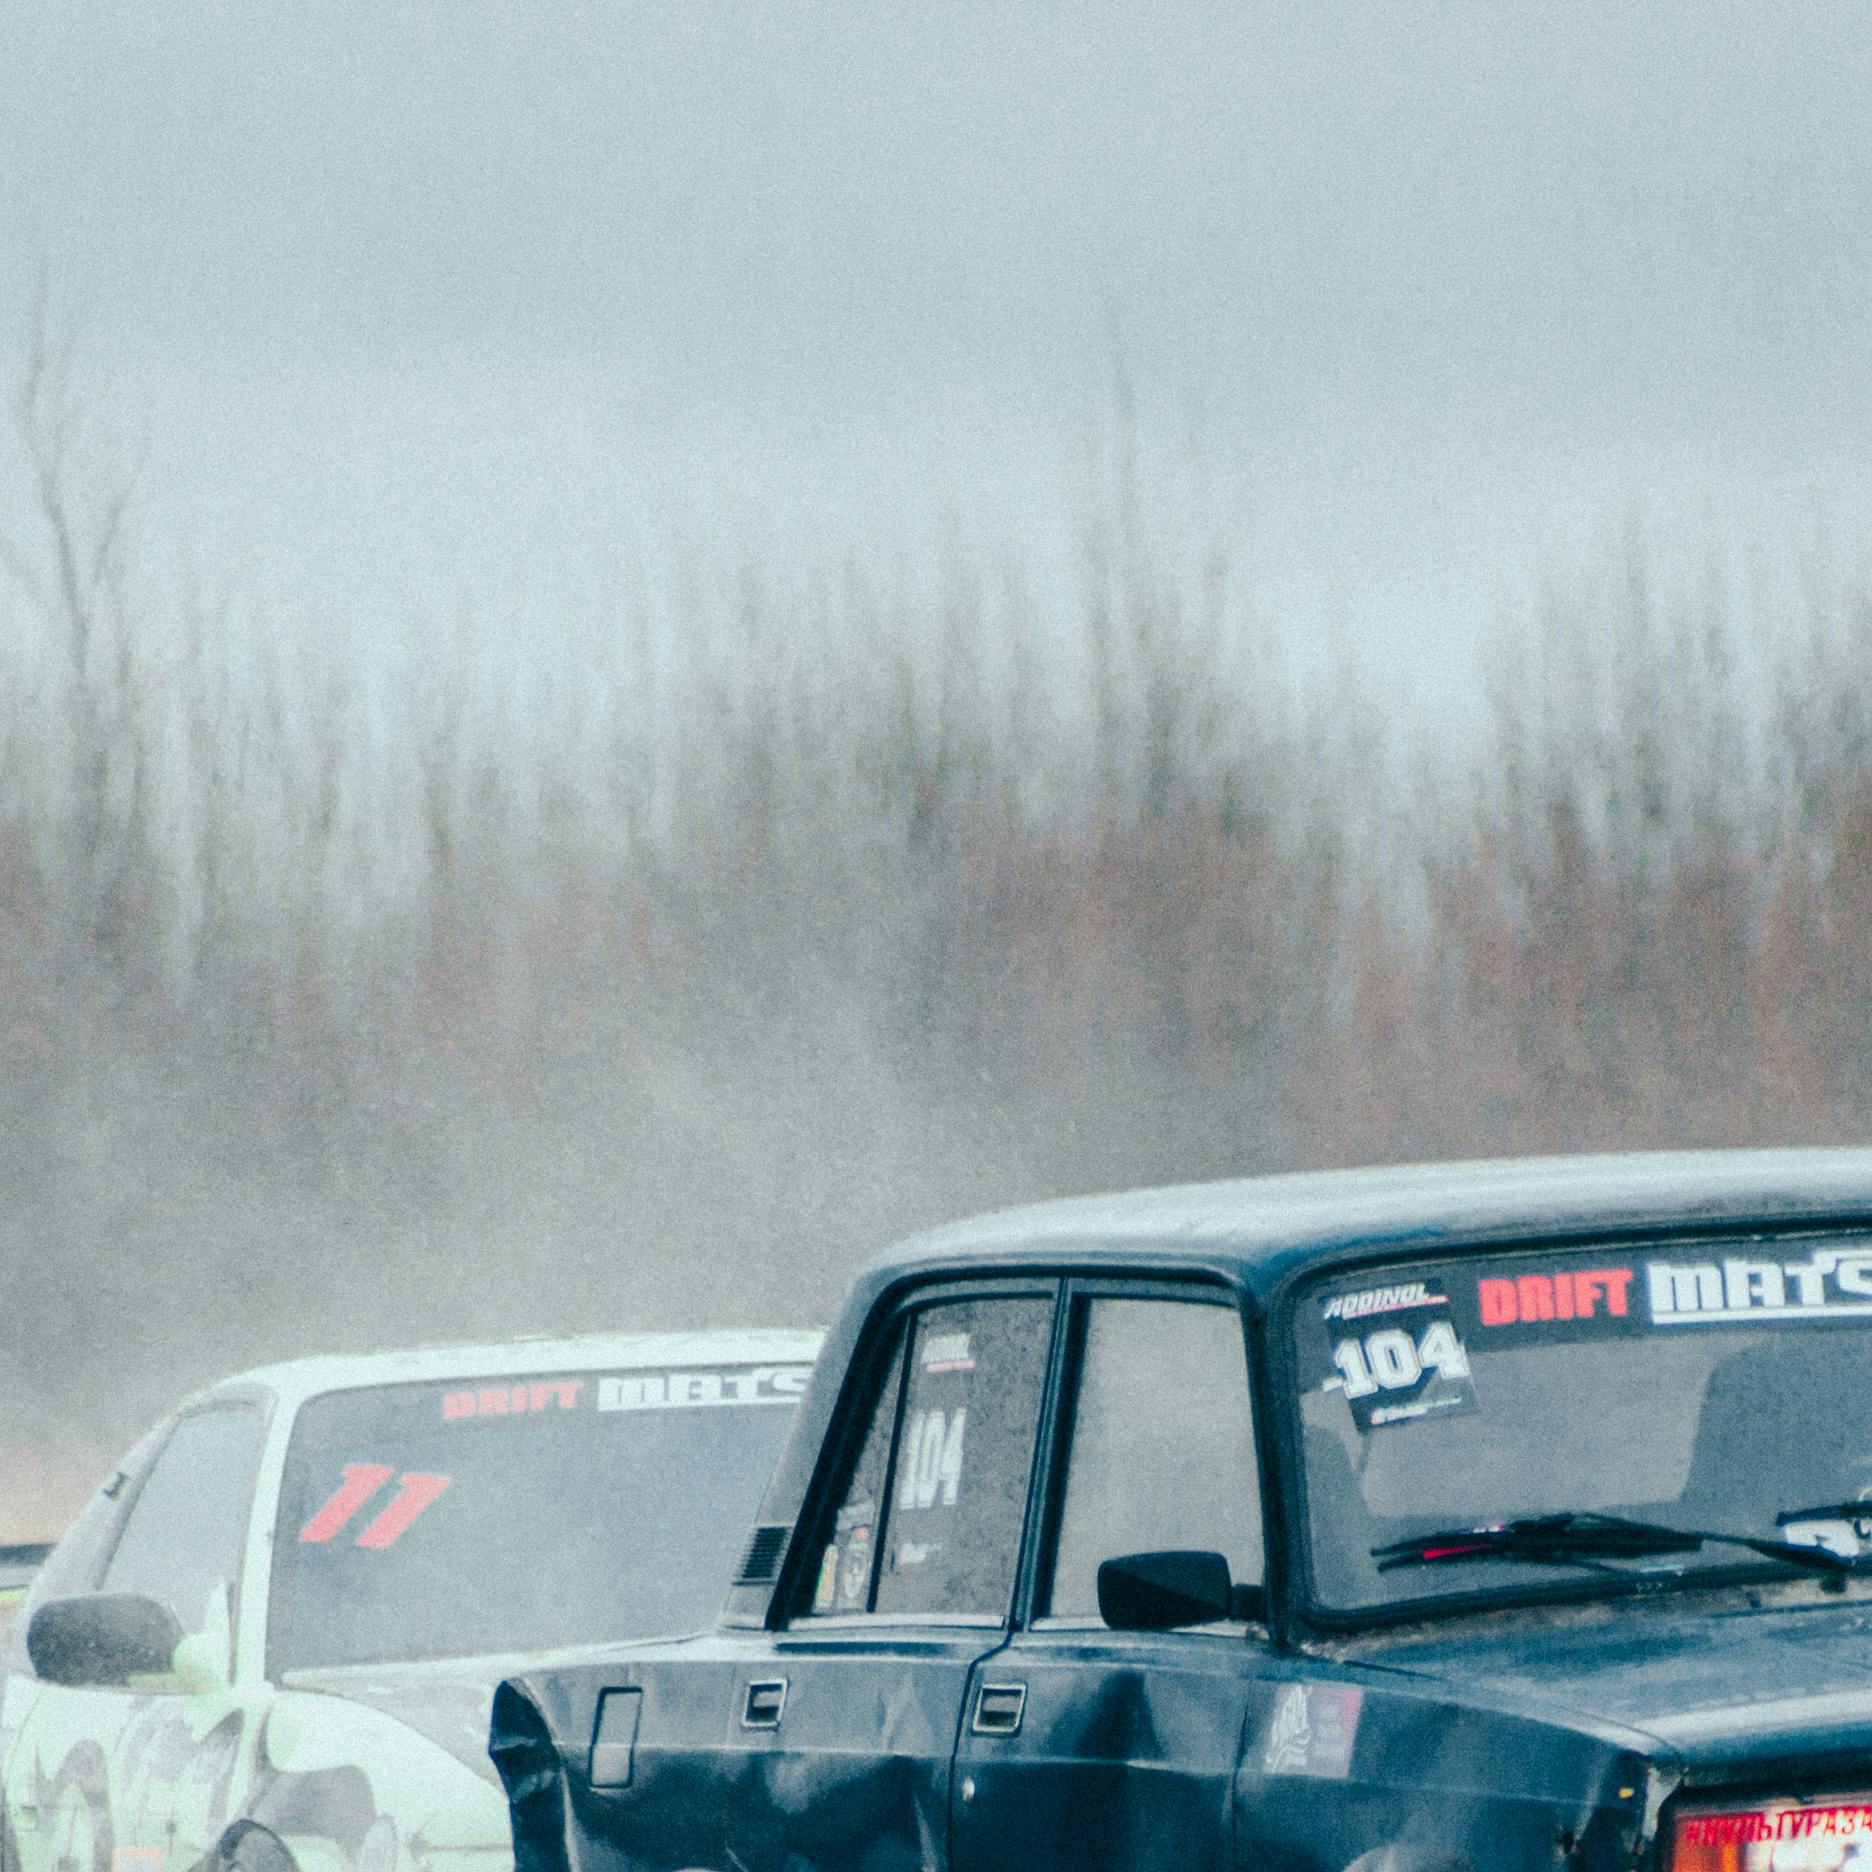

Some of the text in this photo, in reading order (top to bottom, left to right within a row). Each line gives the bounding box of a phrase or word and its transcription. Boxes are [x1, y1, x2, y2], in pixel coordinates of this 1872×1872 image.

[1478, 1268, 1632, 1327] DRIFT
[1334, 1321, 1471, 1399] 104
[443, 1381, 582, 1420] DRIFT
[899, 1407, 968, 1510] 104
[297, 1464, 453, 1549] 11
